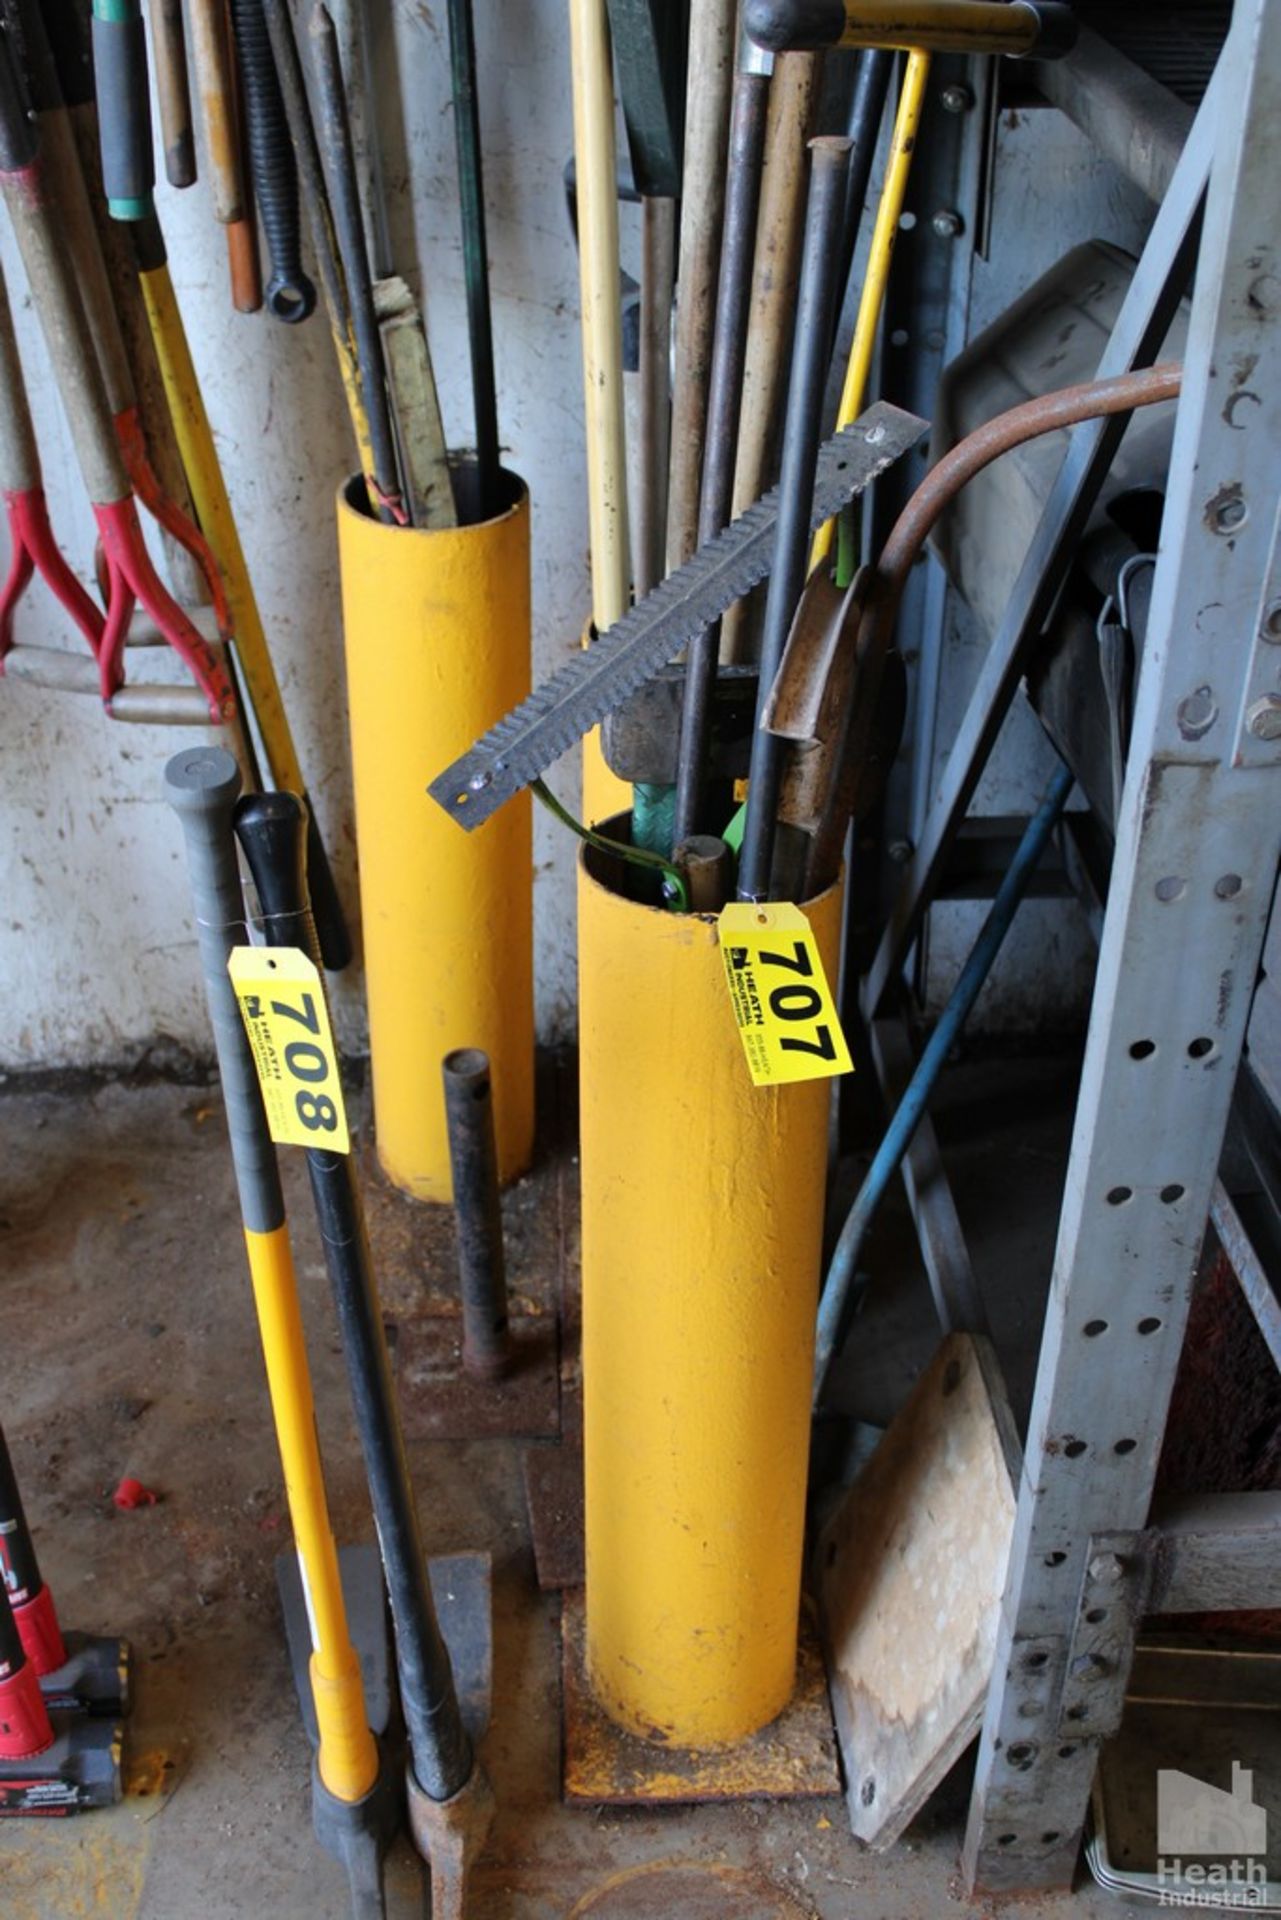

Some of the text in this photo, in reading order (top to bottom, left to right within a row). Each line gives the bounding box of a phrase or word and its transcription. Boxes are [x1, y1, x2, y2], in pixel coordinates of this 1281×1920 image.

[735, 973, 753, 1027] INDUSTRIAL
[745, 971, 764, 1026] HEATH
[758, 941, 837, 1061] 707
[260, 1021, 282, 1081] HEATH
[270, 993, 338, 1132] 708
